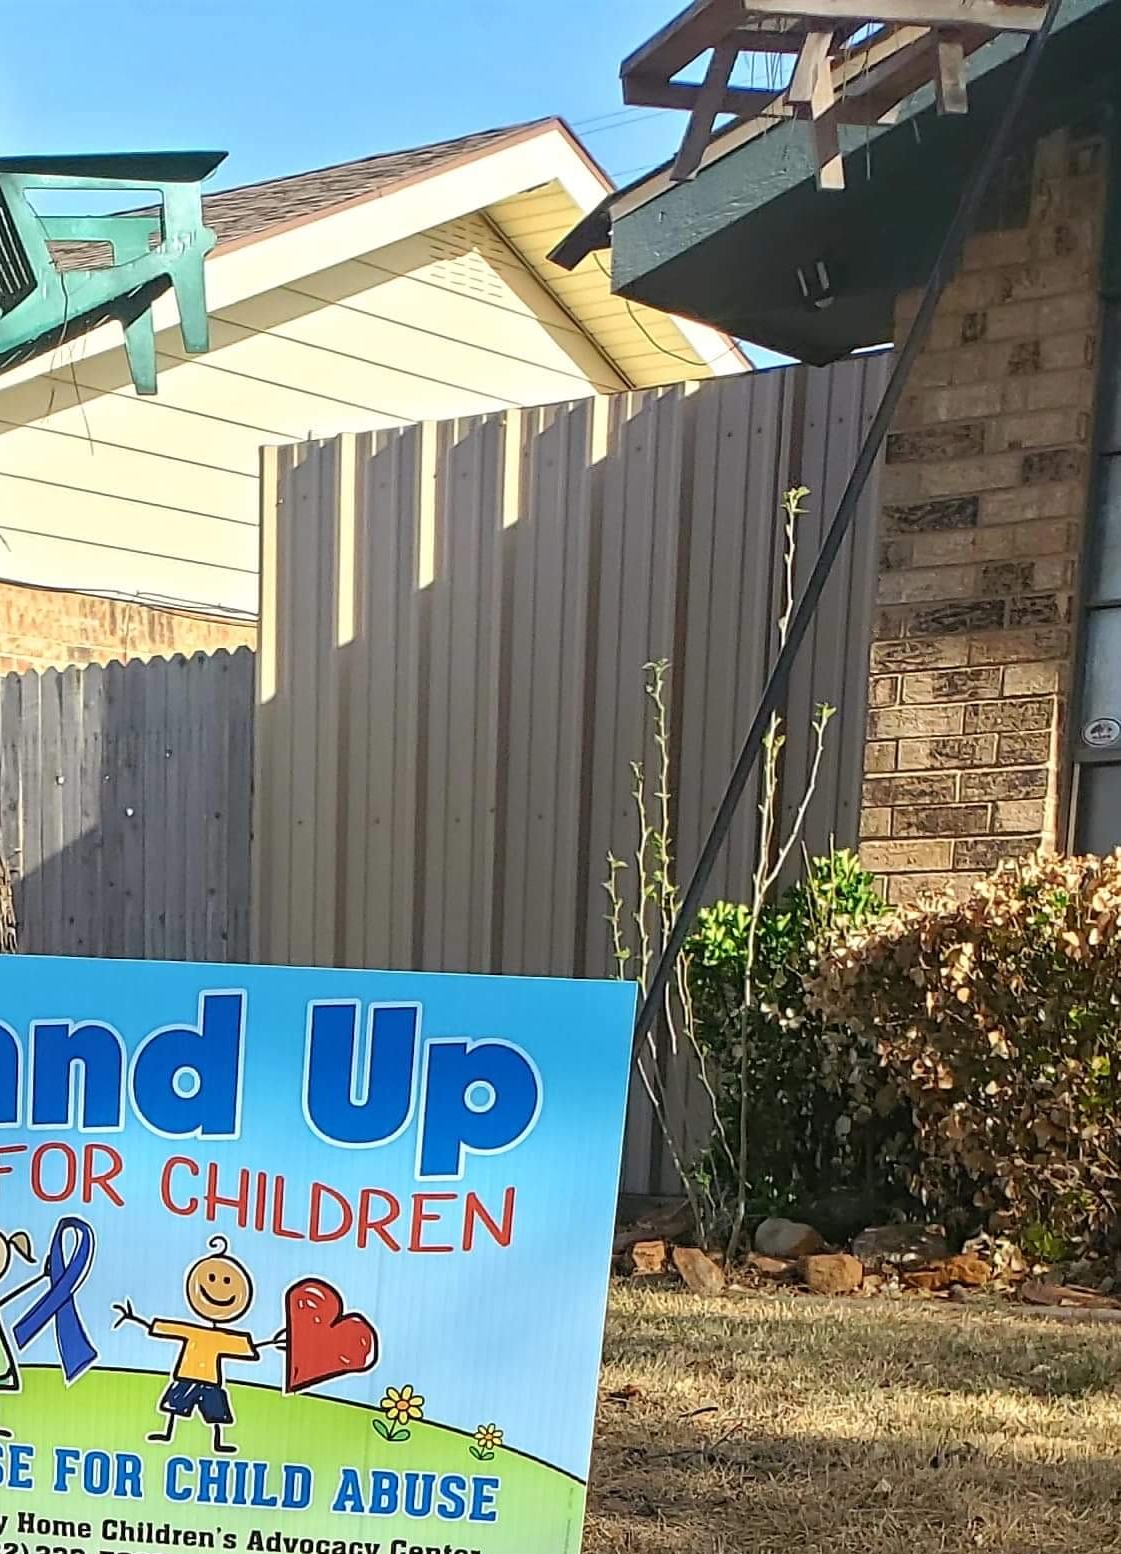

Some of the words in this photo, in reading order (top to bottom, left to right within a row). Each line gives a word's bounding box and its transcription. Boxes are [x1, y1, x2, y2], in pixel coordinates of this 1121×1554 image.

[306, 1002, 540, 1179] Up
[161, 1157, 515, 1252] CHILDREN
[54, 1448, 142, 1497] FOR
[165, 1457, 312, 1508] CHILD
[333, 1468, 499, 1521] ABUSE
[17, 1512, 92, 1538] Home
[102, 1520, 236, 1549] Children's
